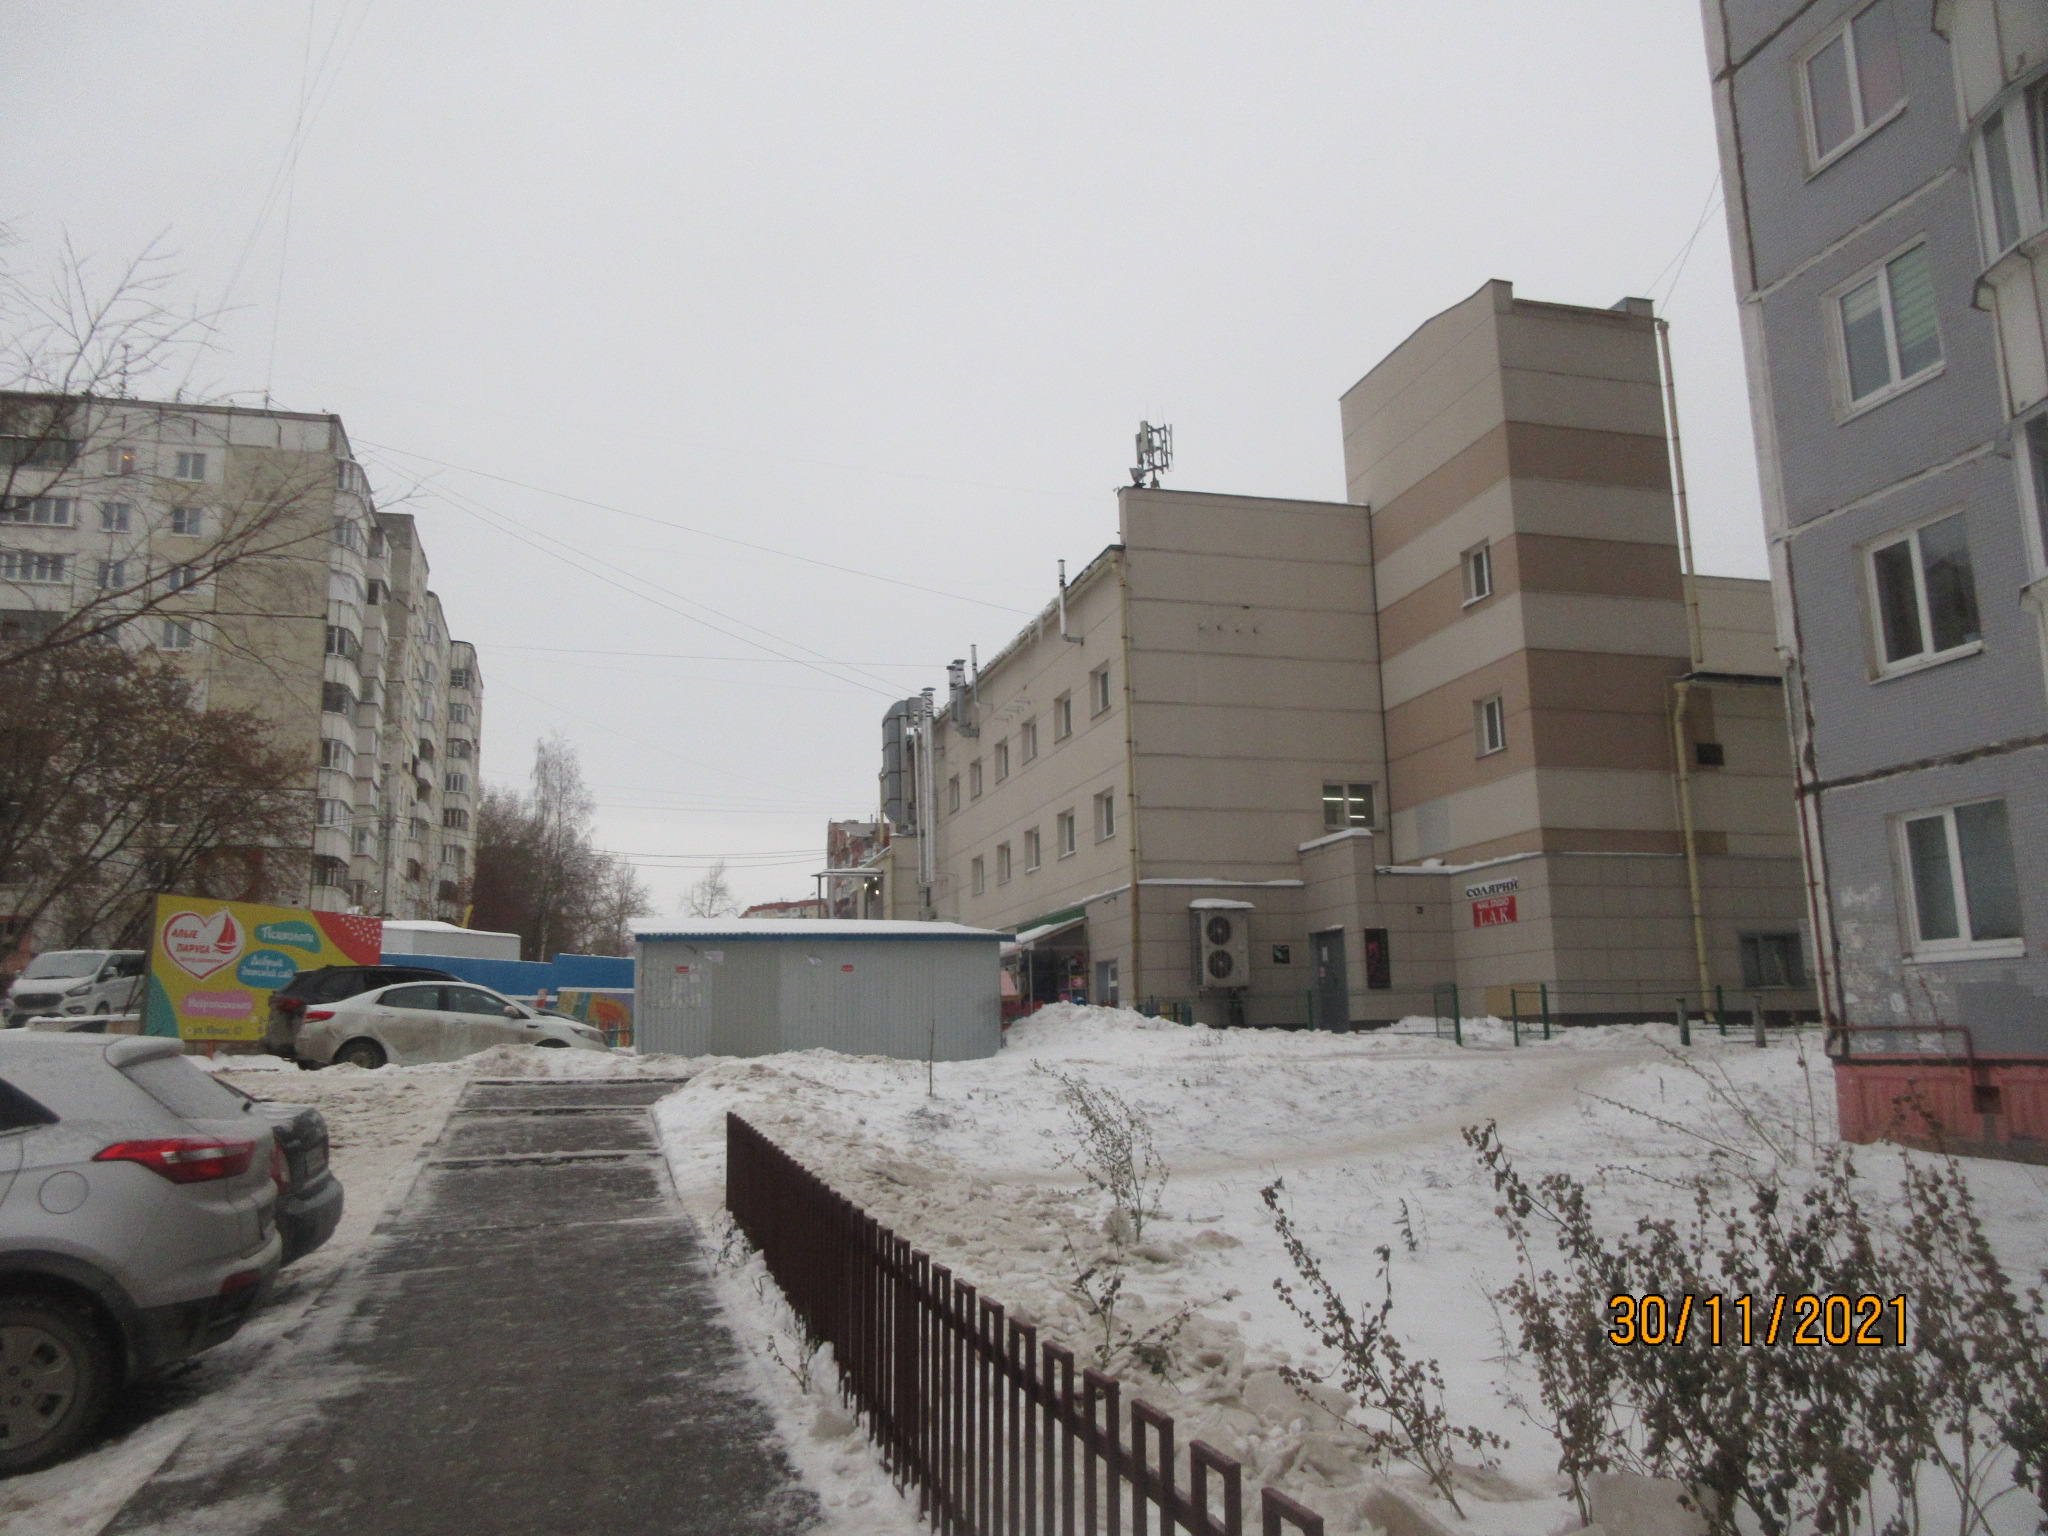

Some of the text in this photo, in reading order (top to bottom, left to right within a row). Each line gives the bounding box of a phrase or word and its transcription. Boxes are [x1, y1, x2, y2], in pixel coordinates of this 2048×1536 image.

[1466, 878, 1519, 898] СОЛЯРИЙ
[171, 928, 199, 939] АЛЫЕ
[176, 943, 211, 954] ПАРУСА
